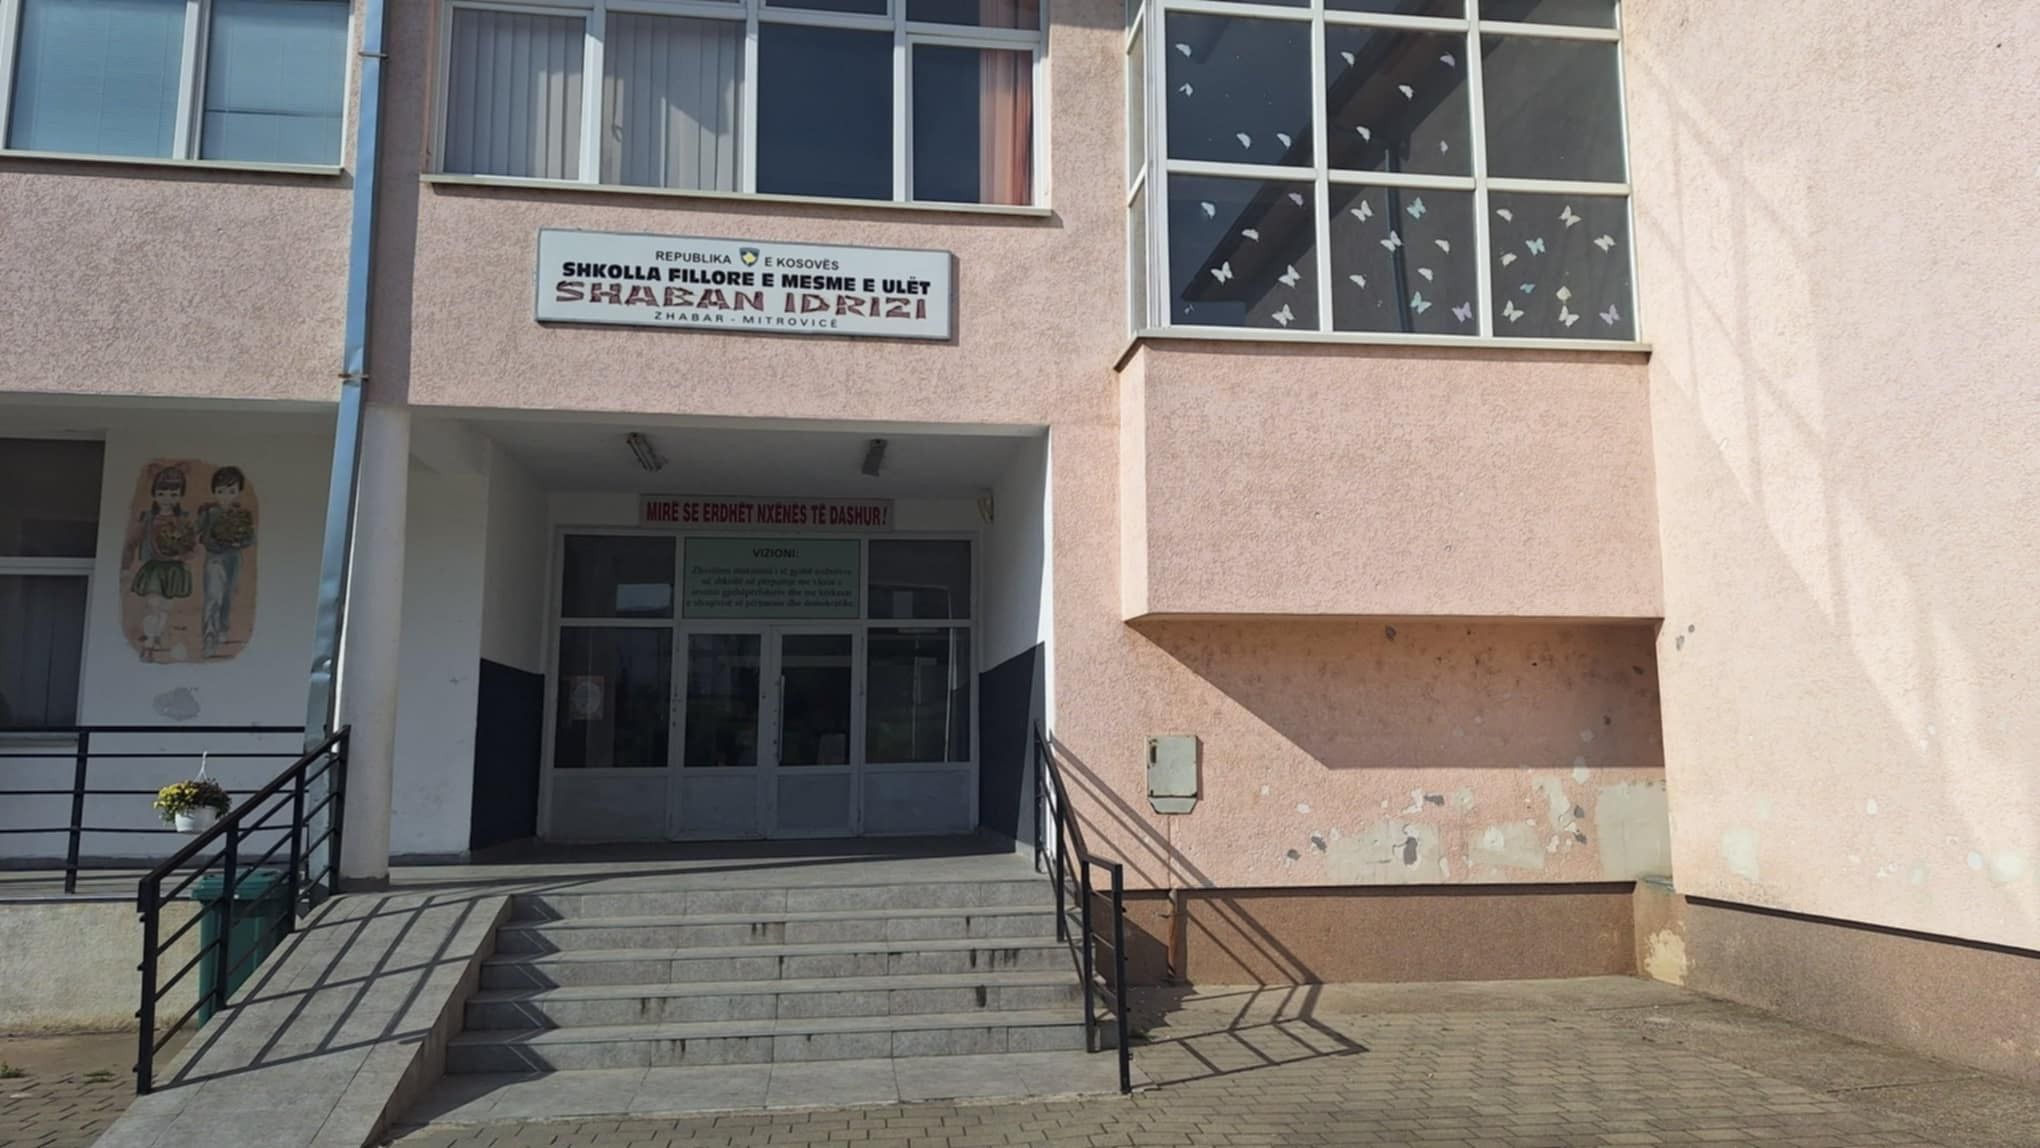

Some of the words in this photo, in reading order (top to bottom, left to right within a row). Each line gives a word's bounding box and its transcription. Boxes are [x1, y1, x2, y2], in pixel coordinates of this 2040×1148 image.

[655, 250, 732, 265] REPUBLIKA
[764, 256, 773, 268] E
[776, 256, 840, 271] KOSOVËS
[562, 261, 662, 282] SHKOLLA
[668, 267, 755, 287] FILLORE
[762, 273, 774, 288] E
[781, 273, 856, 292] MESME
[863, 278, 875, 293] E
[882, 275, 931, 296] ULËT
[555, 280, 764, 312] SHABAN
[784, 291, 927, 320] IDRIZI
[654, 311, 724, 323] ZHABAR
[830, 504, 888, 526] DASHUR!
[752, 547, 799, 559] VIZIONI:
